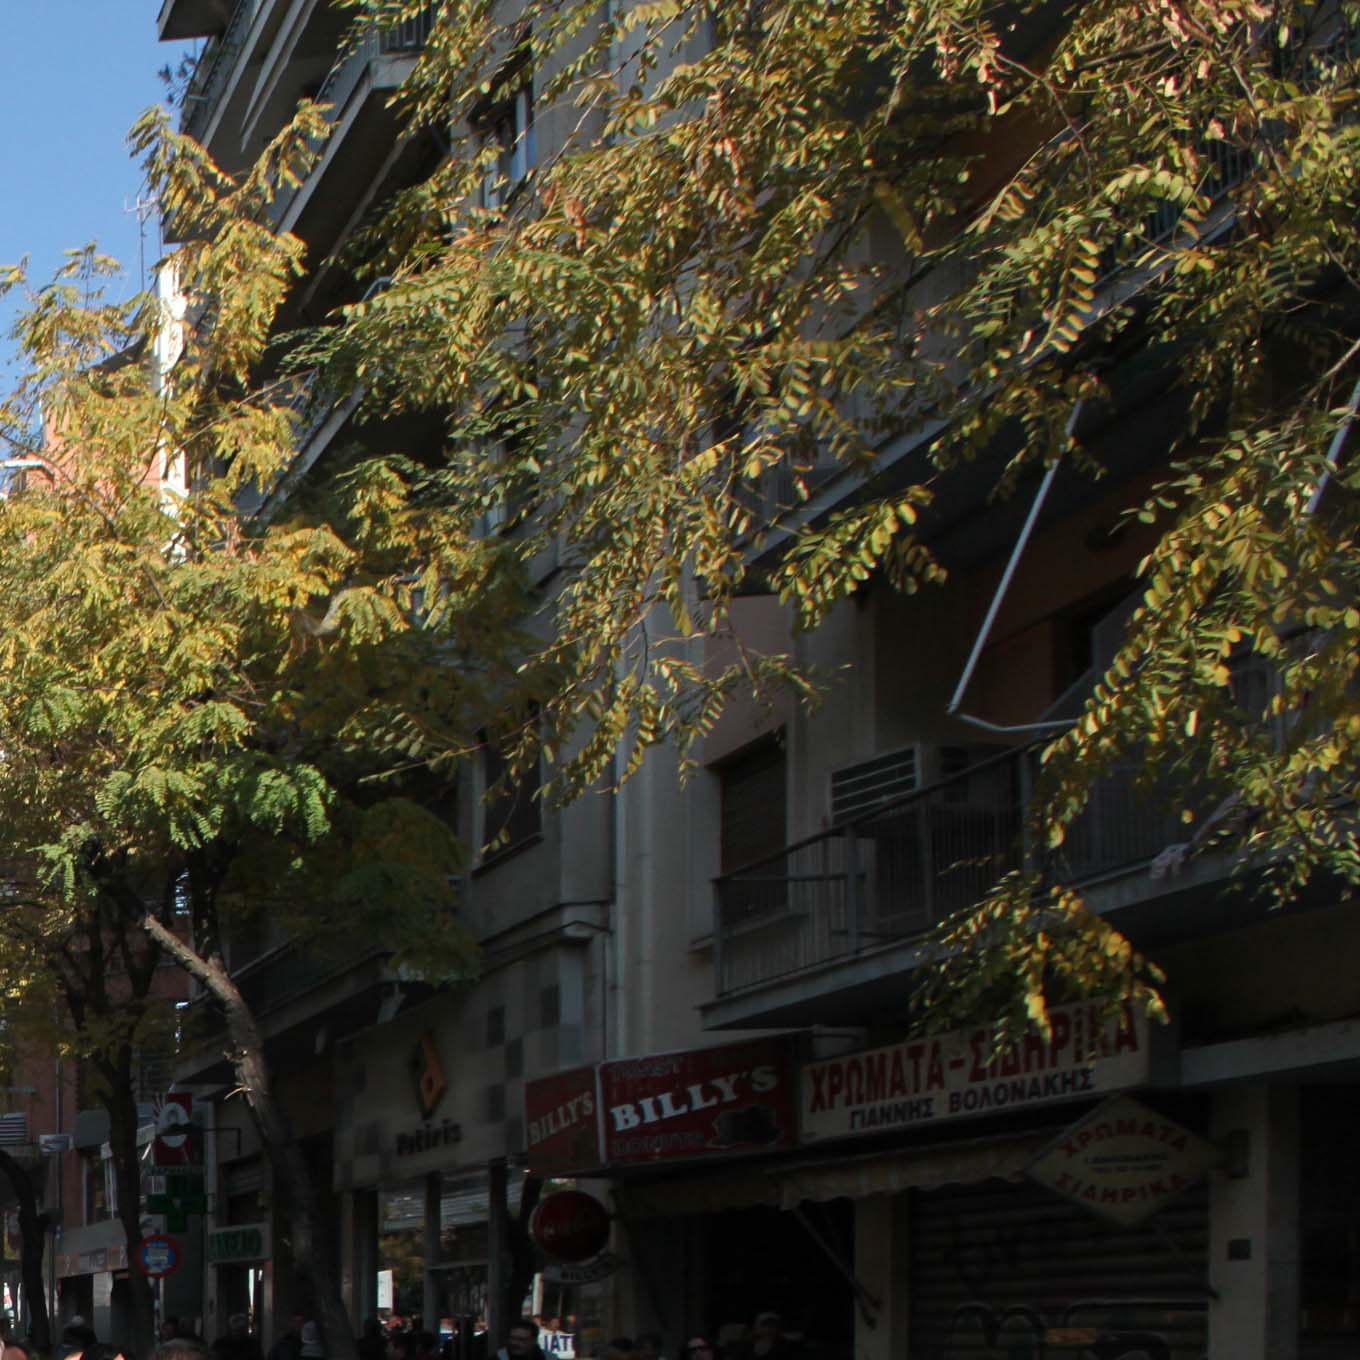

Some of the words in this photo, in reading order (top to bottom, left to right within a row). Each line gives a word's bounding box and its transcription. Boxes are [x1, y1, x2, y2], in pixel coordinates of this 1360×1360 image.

[528, 1090, 594, 1147] BILLY'S
[610, 1064, 778, 1132] BILLY'S
[850, 1098, 935, 1131] ΓΙΑΝΝΗΣ
[949, 1067, 1095, 1114] ΒΟΛΟΝΑΚΗΣ
[1059, 1118, 1189, 1157] ΧΡΩΜΑΤΑ
[1055, 1172, 1186, 1204] ΣΙΔΗΡΙΚΑ
